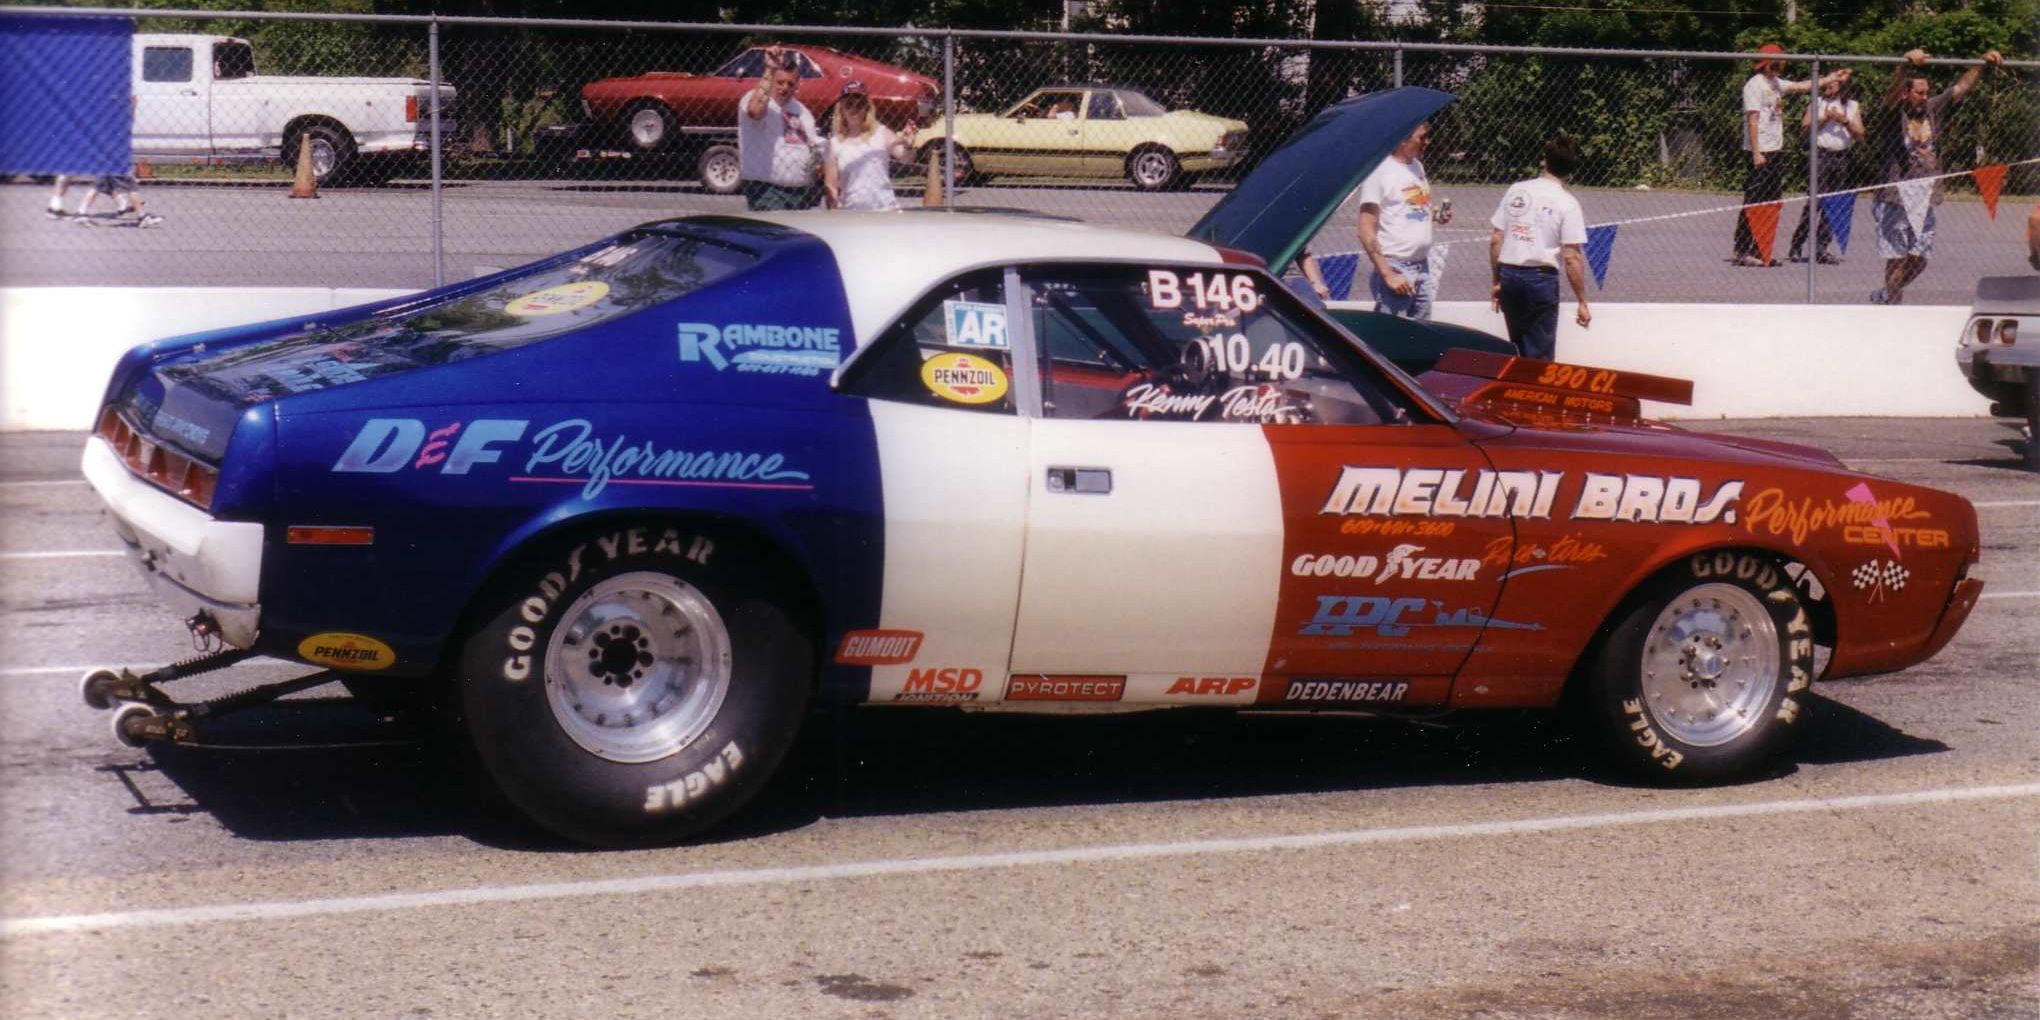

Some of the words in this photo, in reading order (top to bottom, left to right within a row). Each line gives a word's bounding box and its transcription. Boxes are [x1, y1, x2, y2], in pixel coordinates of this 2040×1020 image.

[1149, 270, 1182, 308] B
[1186, 272, 1258, 313] 146
[956, 309, 1007, 346] AR
[677, 322, 841, 371] RAMBONE
[1209, 333, 1305, 380] 10.40
[934, 368, 996, 386] PENNZOIL
[1537, 363, 1588, 389] 390
[1126, 383, 1215, 421] Kenny
[1503, 388, 1558, 406] AMERICAN
[1563, 395, 1614, 414] MOTORS
[524, 418, 810, 500] Performance
[1319, 465, 1562, 519] MELINI
[1744, 487, 1931, 546] Performance
[1843, 525, 1949, 548] CENTER
[314, 645, 379, 661] PENNZOIL
[843, 635, 919, 658] GUMOUT
[903, 667, 984, 692] MSD
[1010, 681, 1122, 696] PYROTECT
[1166, 677, 1257, 695] ARP
[1285, 681, 1409, 701] DEDENBEAR
[1623, 695, 1684, 772] EAGLE
[643, 740, 745, 812] EAGLE
